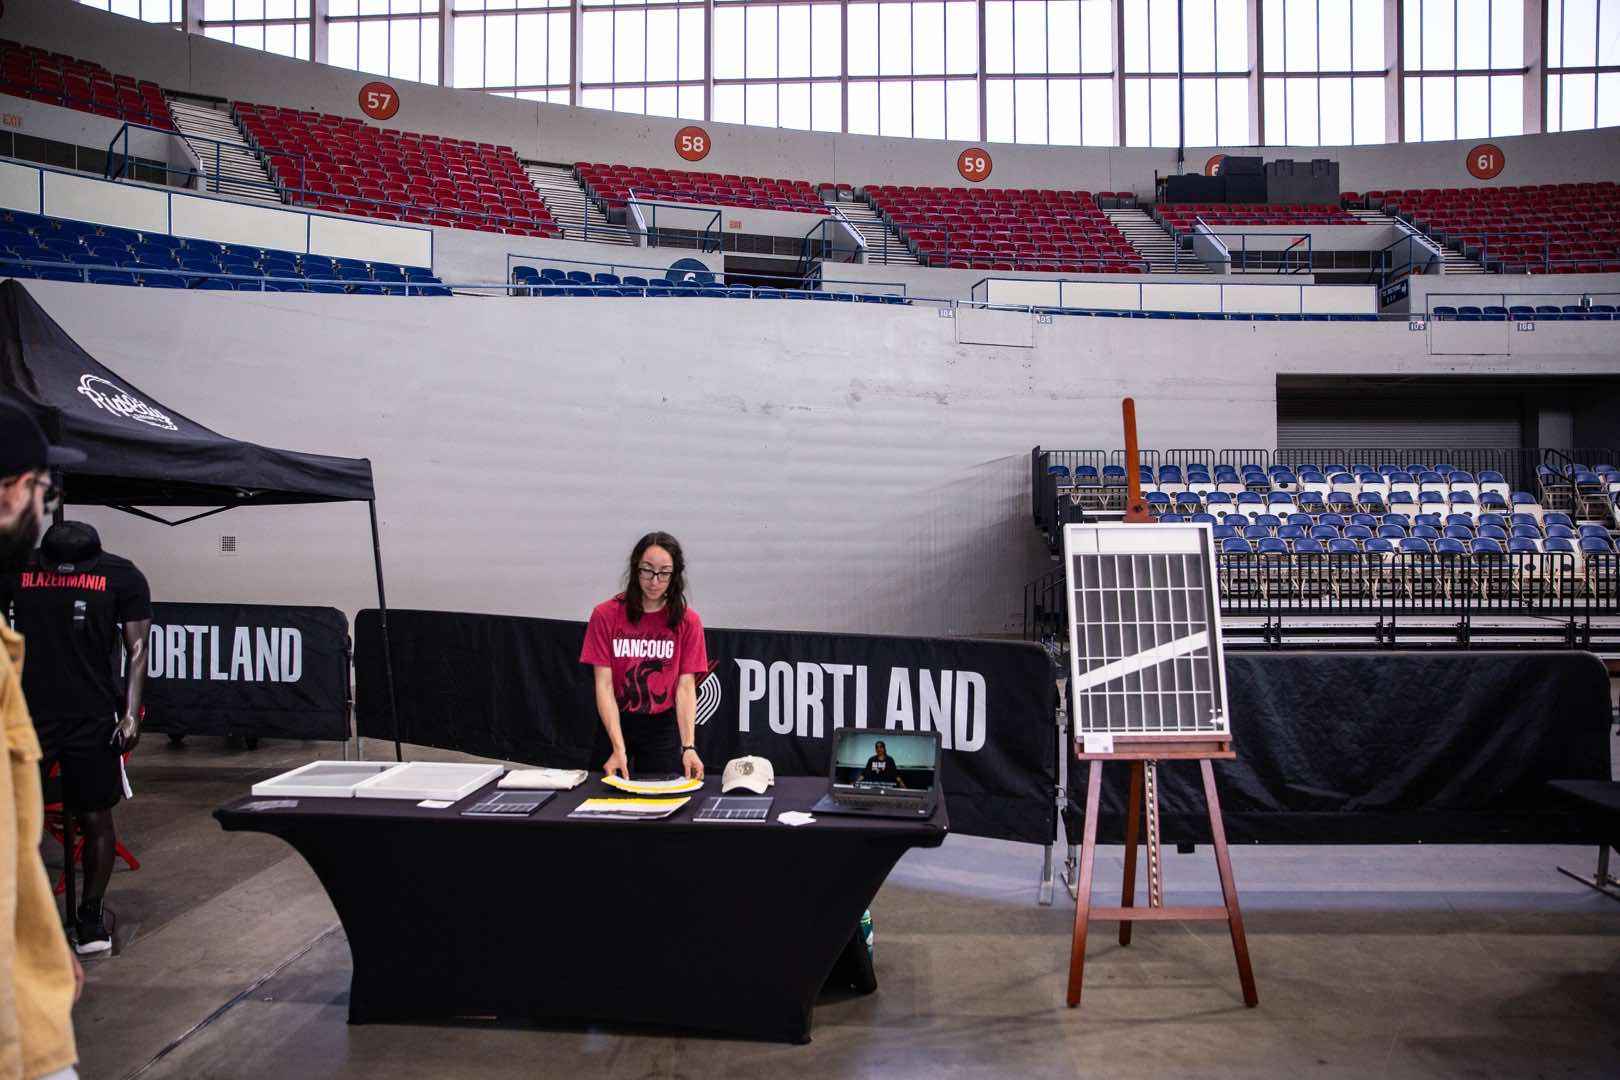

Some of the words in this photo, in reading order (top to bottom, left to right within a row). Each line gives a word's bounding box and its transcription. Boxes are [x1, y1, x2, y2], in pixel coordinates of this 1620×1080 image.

[368, 92, 391, 110] 57
[682, 135, 704, 152] 58
[964, 157, 985, 173] 59
[1478, 154, 1494, 170] 61
[612, 638, 674, 659] VANCOUG
